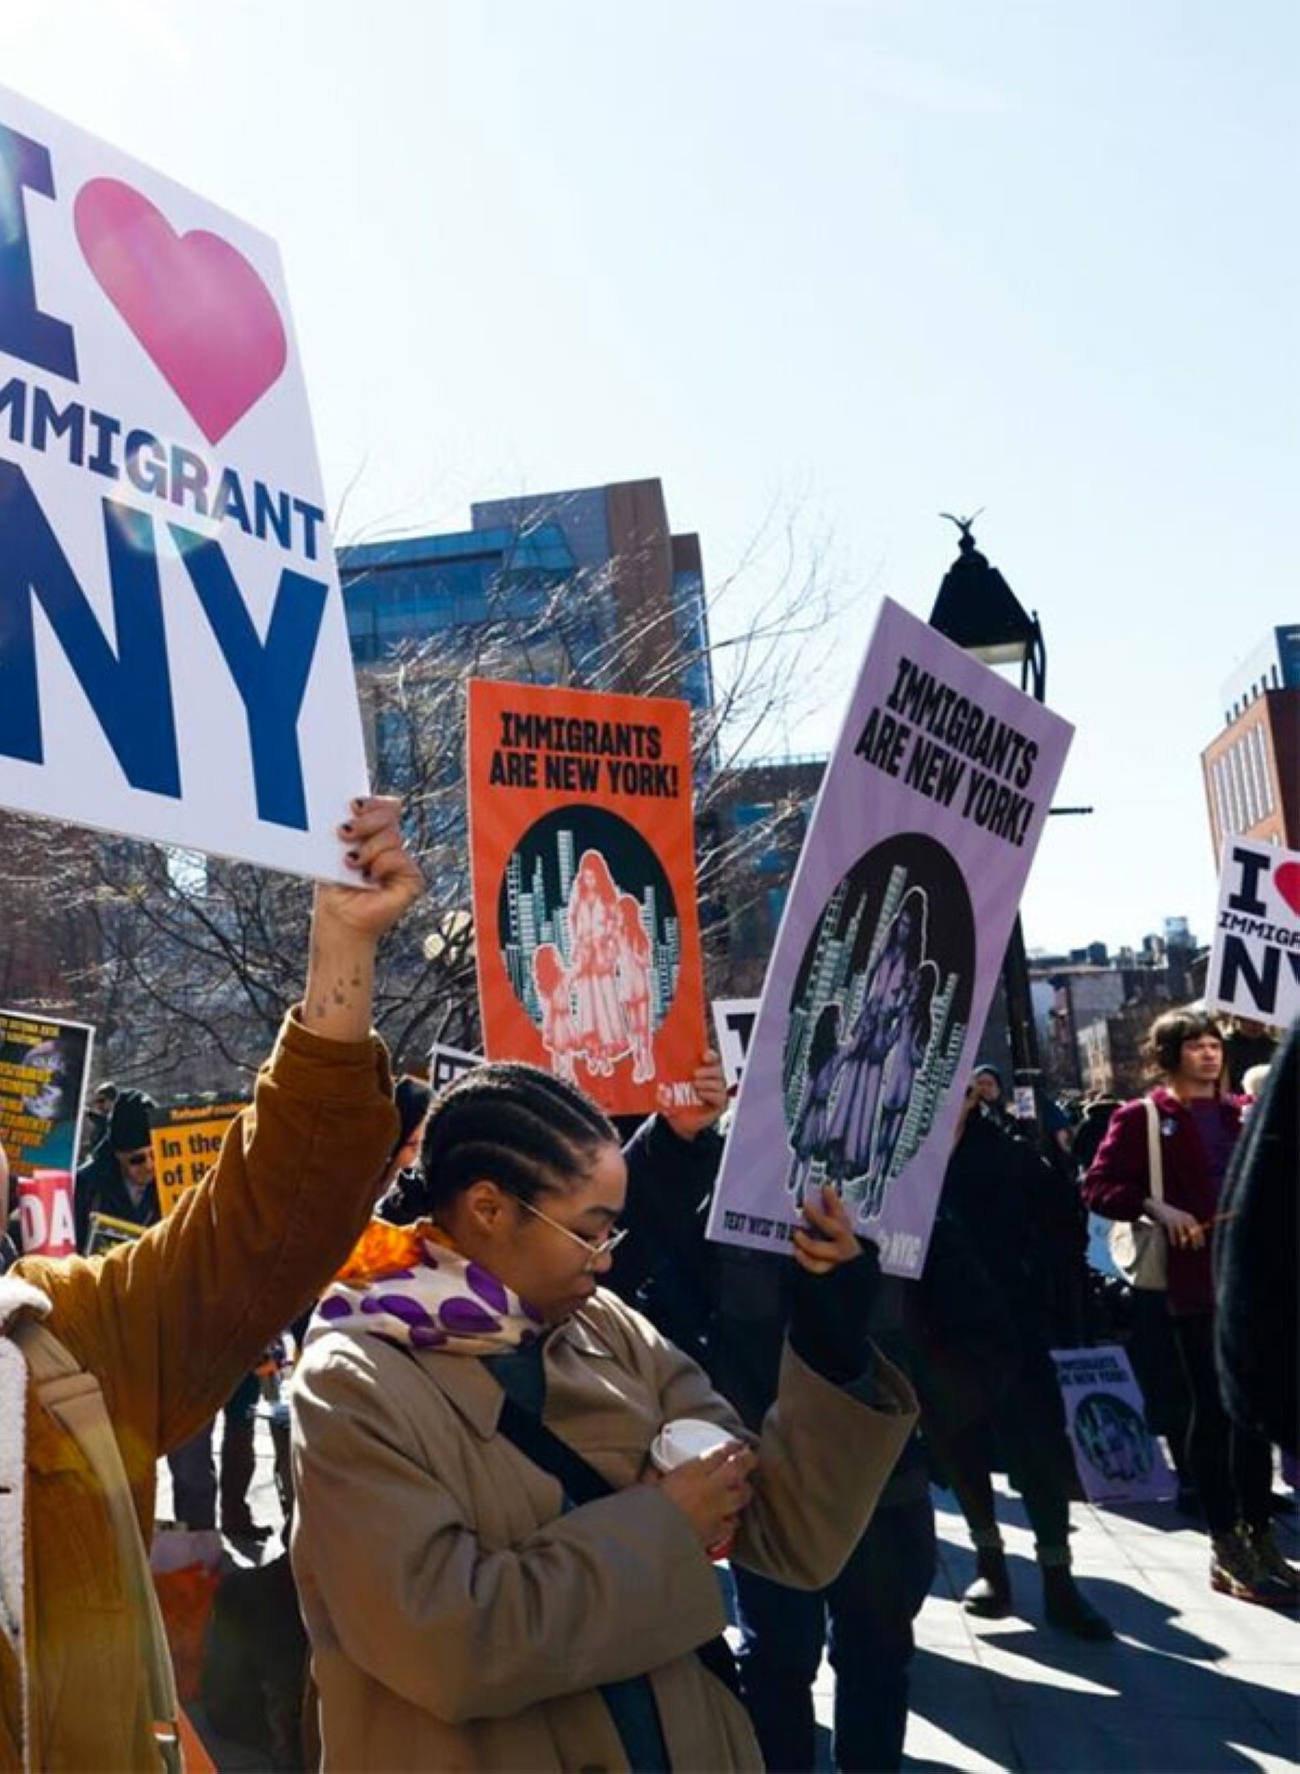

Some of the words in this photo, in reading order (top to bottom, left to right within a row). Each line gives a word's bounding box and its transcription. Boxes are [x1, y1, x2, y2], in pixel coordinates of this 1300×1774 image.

[501, 712, 661, 760] IMMIGRANTS
[886, 656, 1039, 789] IMMIGRANTS
[489, 750, 538, 789] ARE
[544, 755, 599, 792] NEW
[607, 759, 679, 798] YORK!
[854, 706, 911, 778] ARE
[903, 735, 966, 807] NEW
[962, 768, 1035, 847] YORK!
[1228, 846, 1271, 917] I
[1218, 934, 1300, 1015] N
[161, 1138, 181, 1158] In
[189, 1133, 222, 1154] the
[163, 1164, 183, 1186] of
